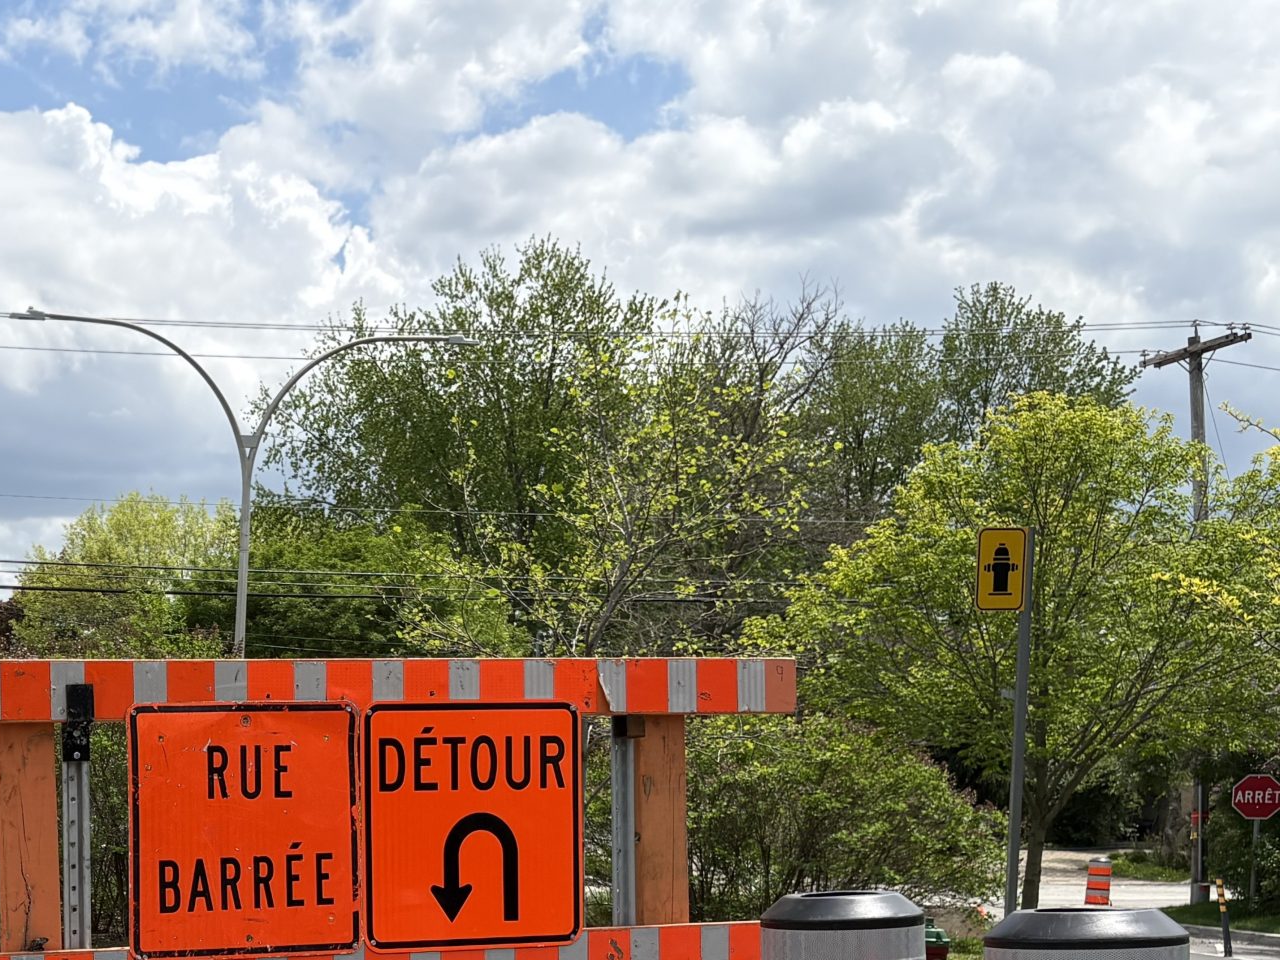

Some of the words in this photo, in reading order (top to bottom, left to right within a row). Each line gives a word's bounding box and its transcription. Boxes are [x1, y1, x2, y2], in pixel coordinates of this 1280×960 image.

[206, 744, 293, 799] RUE
[378, 726, 565, 792] DÉTOUR
[1235, 788, 1280, 804] ARRÊT
[158, 841, 335, 914] BARRÉE
